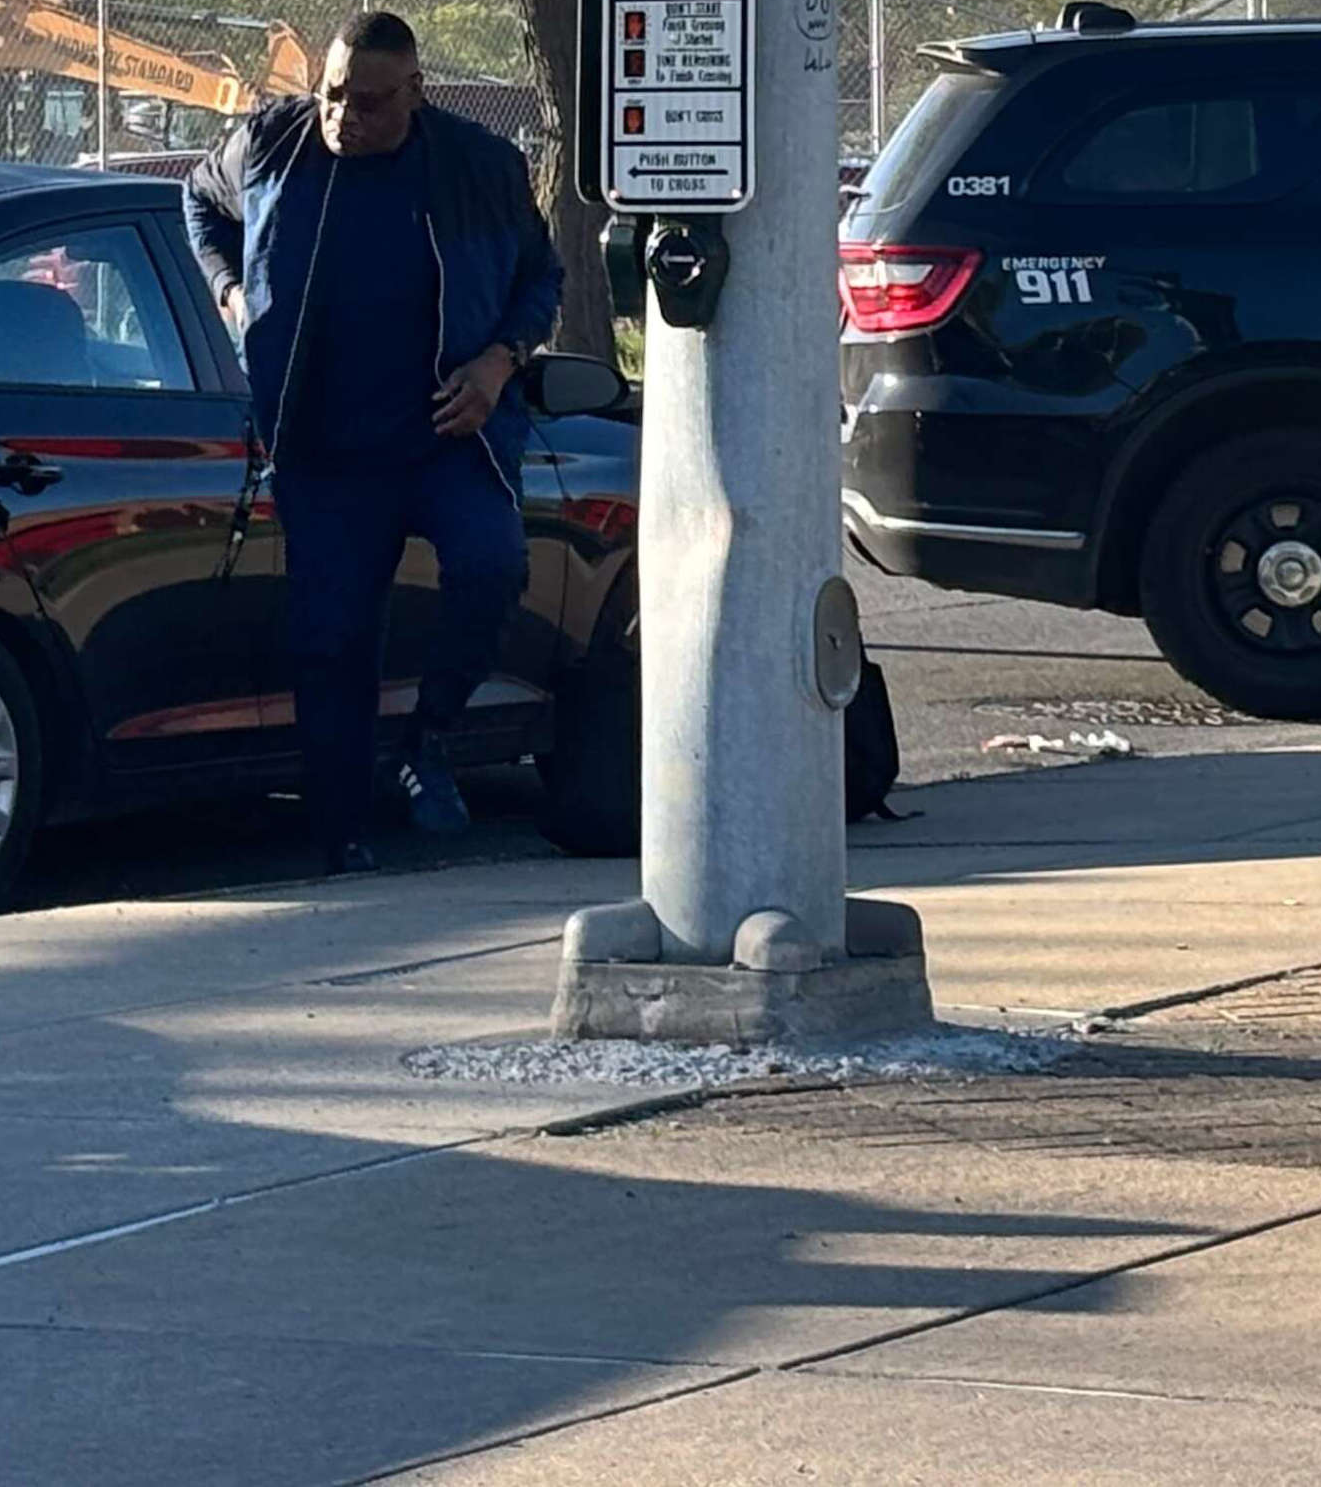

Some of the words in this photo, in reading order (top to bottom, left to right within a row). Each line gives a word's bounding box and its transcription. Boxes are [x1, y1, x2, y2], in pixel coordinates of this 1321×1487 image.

[639, 154, 669, 166] PUSH
[673, 153, 716, 166] BUTTON
[651, 178, 664, 191] TO
[668, 178, 706, 191] CROSS
[948, 175, 1010, 196] 0381
[1002, 256, 1106, 270] EMERGENCY
[1016, 269, 1092, 304] 911
